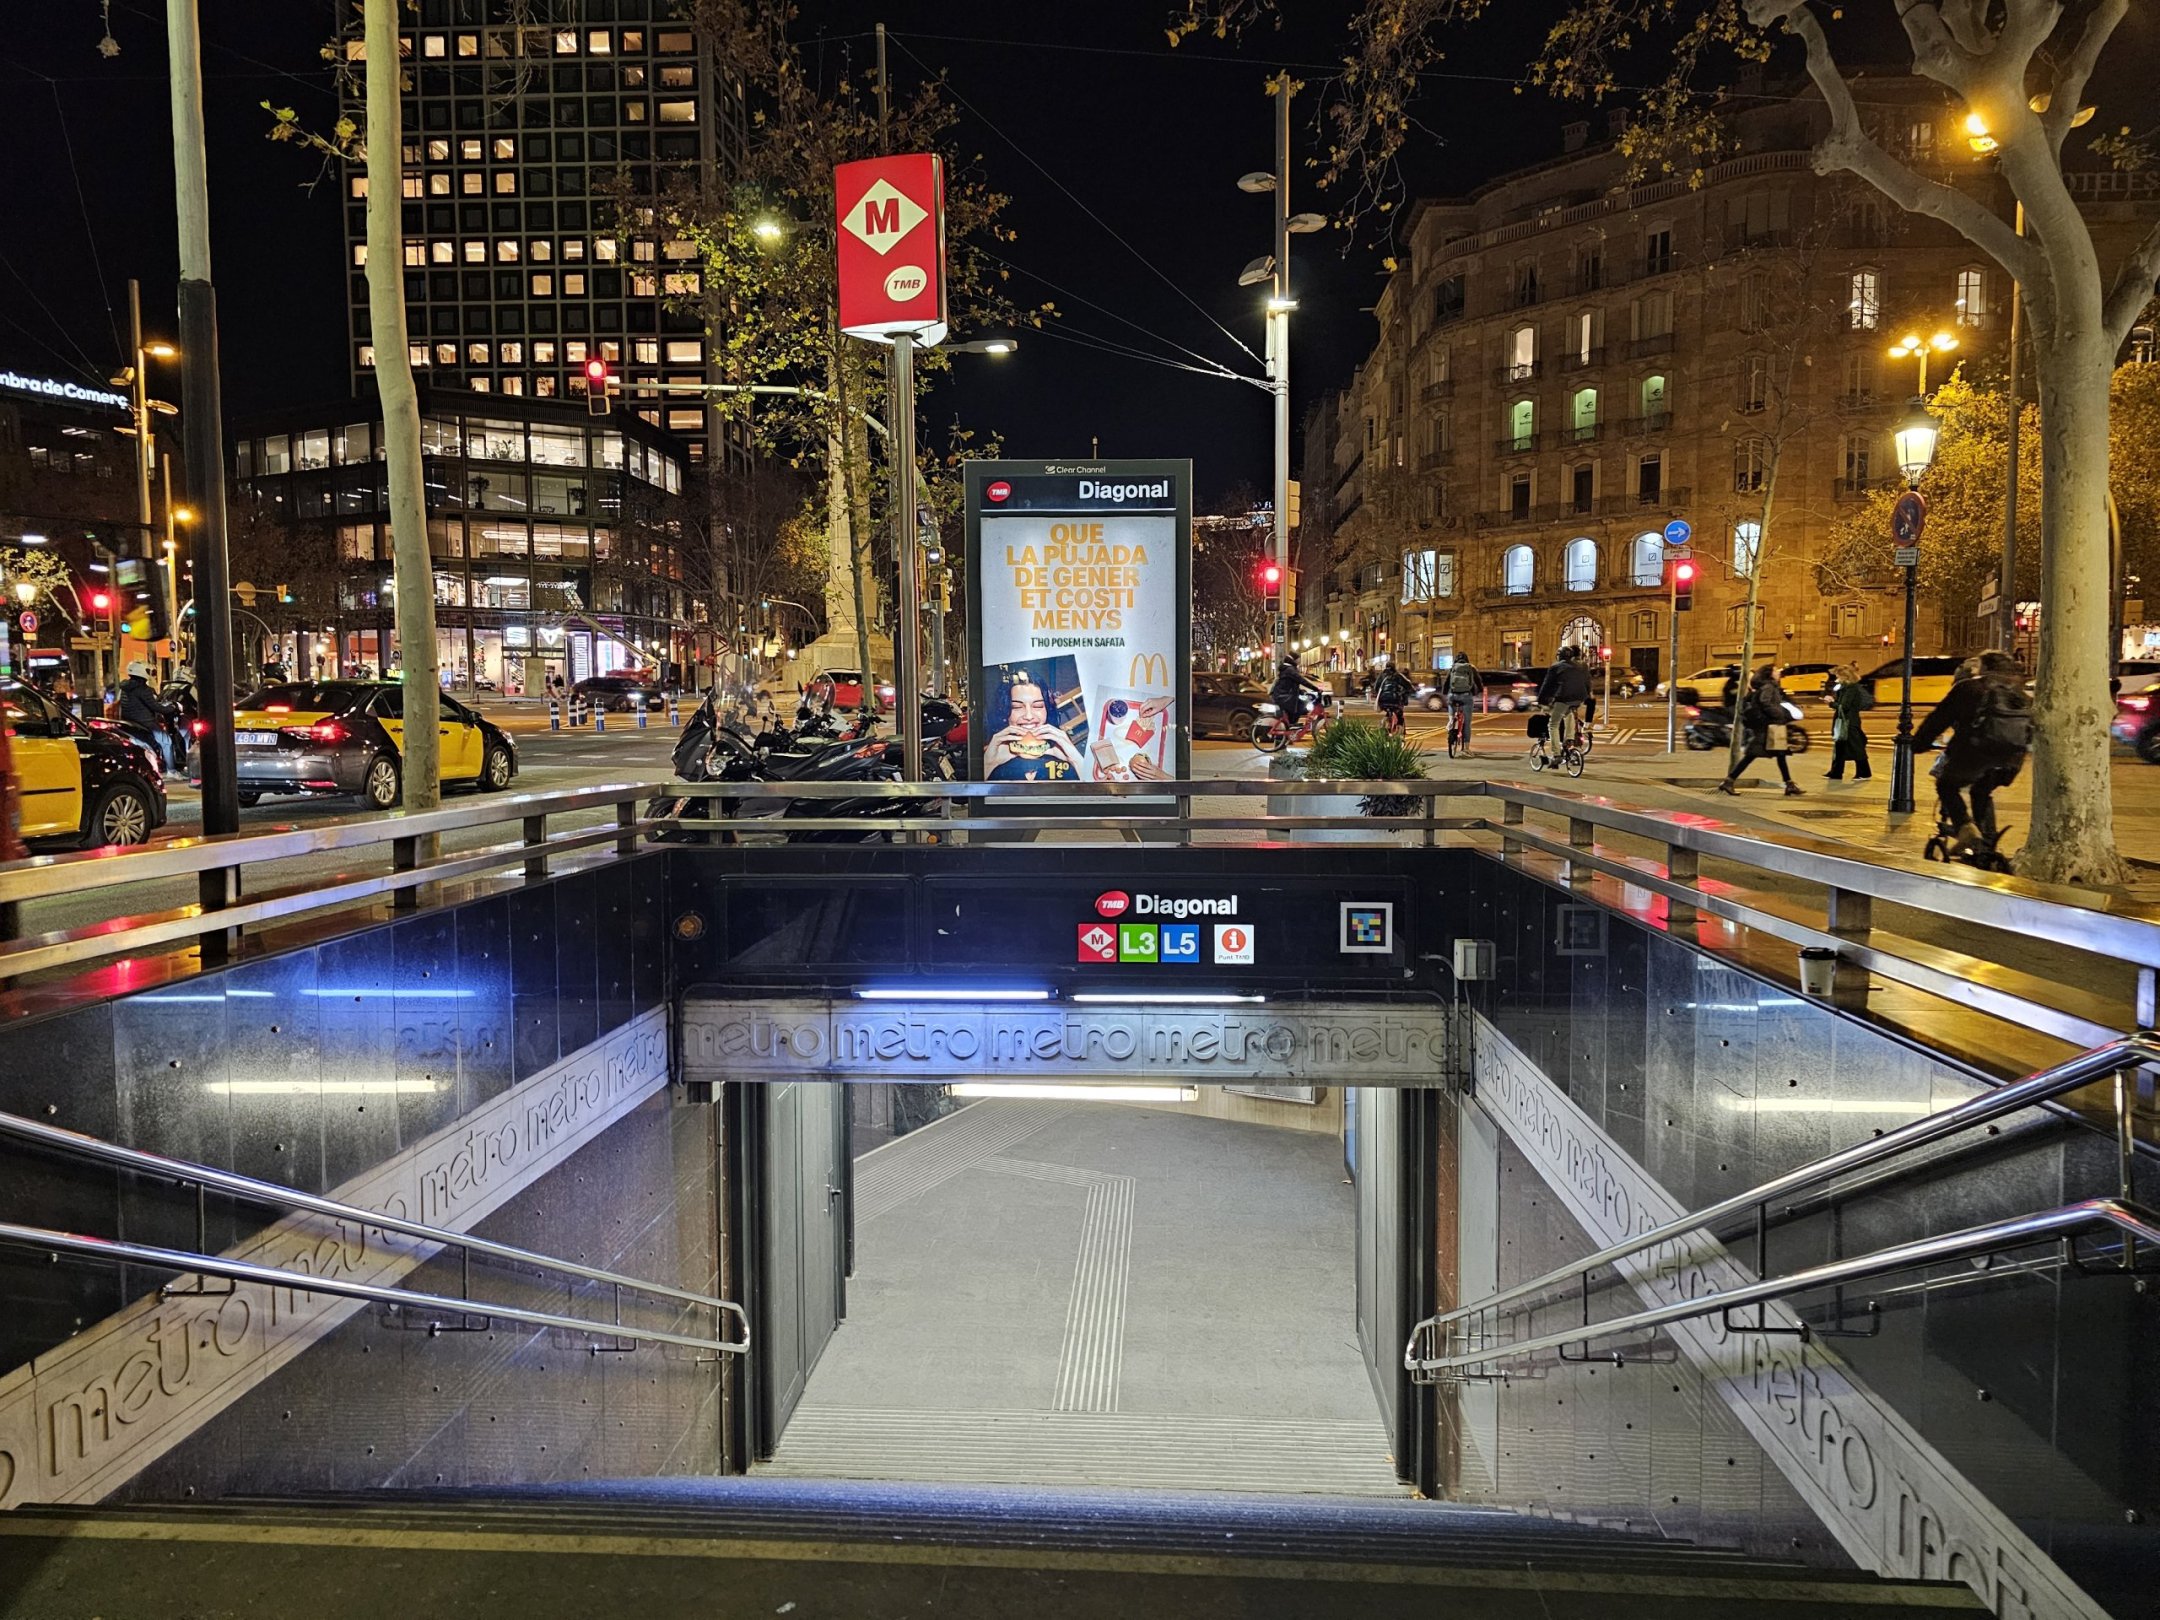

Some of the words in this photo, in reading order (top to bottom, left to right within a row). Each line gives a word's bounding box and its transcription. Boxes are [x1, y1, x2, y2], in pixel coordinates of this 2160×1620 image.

[865, 198, 900, 236] M
[893, 279, 921, 290] TMB
[42, 378, 64, 396] de
[64, 382, 129, 409] Comerç
[1056, 466, 1076, 474] Clear
[1076, 465, 1106, 474] Channel
[991, 488, 1009, 496] TMB
[1079, 480, 1168, 502] Diagonal
[1050, 523, 1104, 546] QUE
[1006, 545, 1039, 566] LA
[1044, 544, 1149, 566] PUJADA
[1014, 566, 1049, 587] DE
[1053, 566, 1140, 587] GENER
[1021, 588, 1052, 609] ET
[1055, 588, 1134, 609] COSTI
[1032, 609, 1122, 630] MENYS
[1051, 637, 1080, 648] POSEM
[1082, 637, 1093, 648] EN
[1094, 637, 1125, 648] SAFATA
[1101, 900, 1124, 909] TMB
[1135, 894, 1238, 918] Diagonal
[1091, 934, 1104, 945] M
[1123, 931, 1155, 955] L3
[1164, 931, 1196, 955] L5
[684, 1010, 825, 1059] metro
[836, 1008, 980, 1060] metro
[992, 1010, 1137, 1060] metro
[1149, 1012, 1297, 1062] metro
[1307, 1014, 1450, 1064] metro
[48, 1290, 255, 1477] metro
[419, 1120, 518, 1225] metro
[526, 1067, 601, 1152] metro
[606, 1027, 665, 1098] metro
[1513, 1073, 1563, 1161] metro
[1566, 1127, 1631, 1237] metro
[1739, 1306, 1878, 1510] metro
